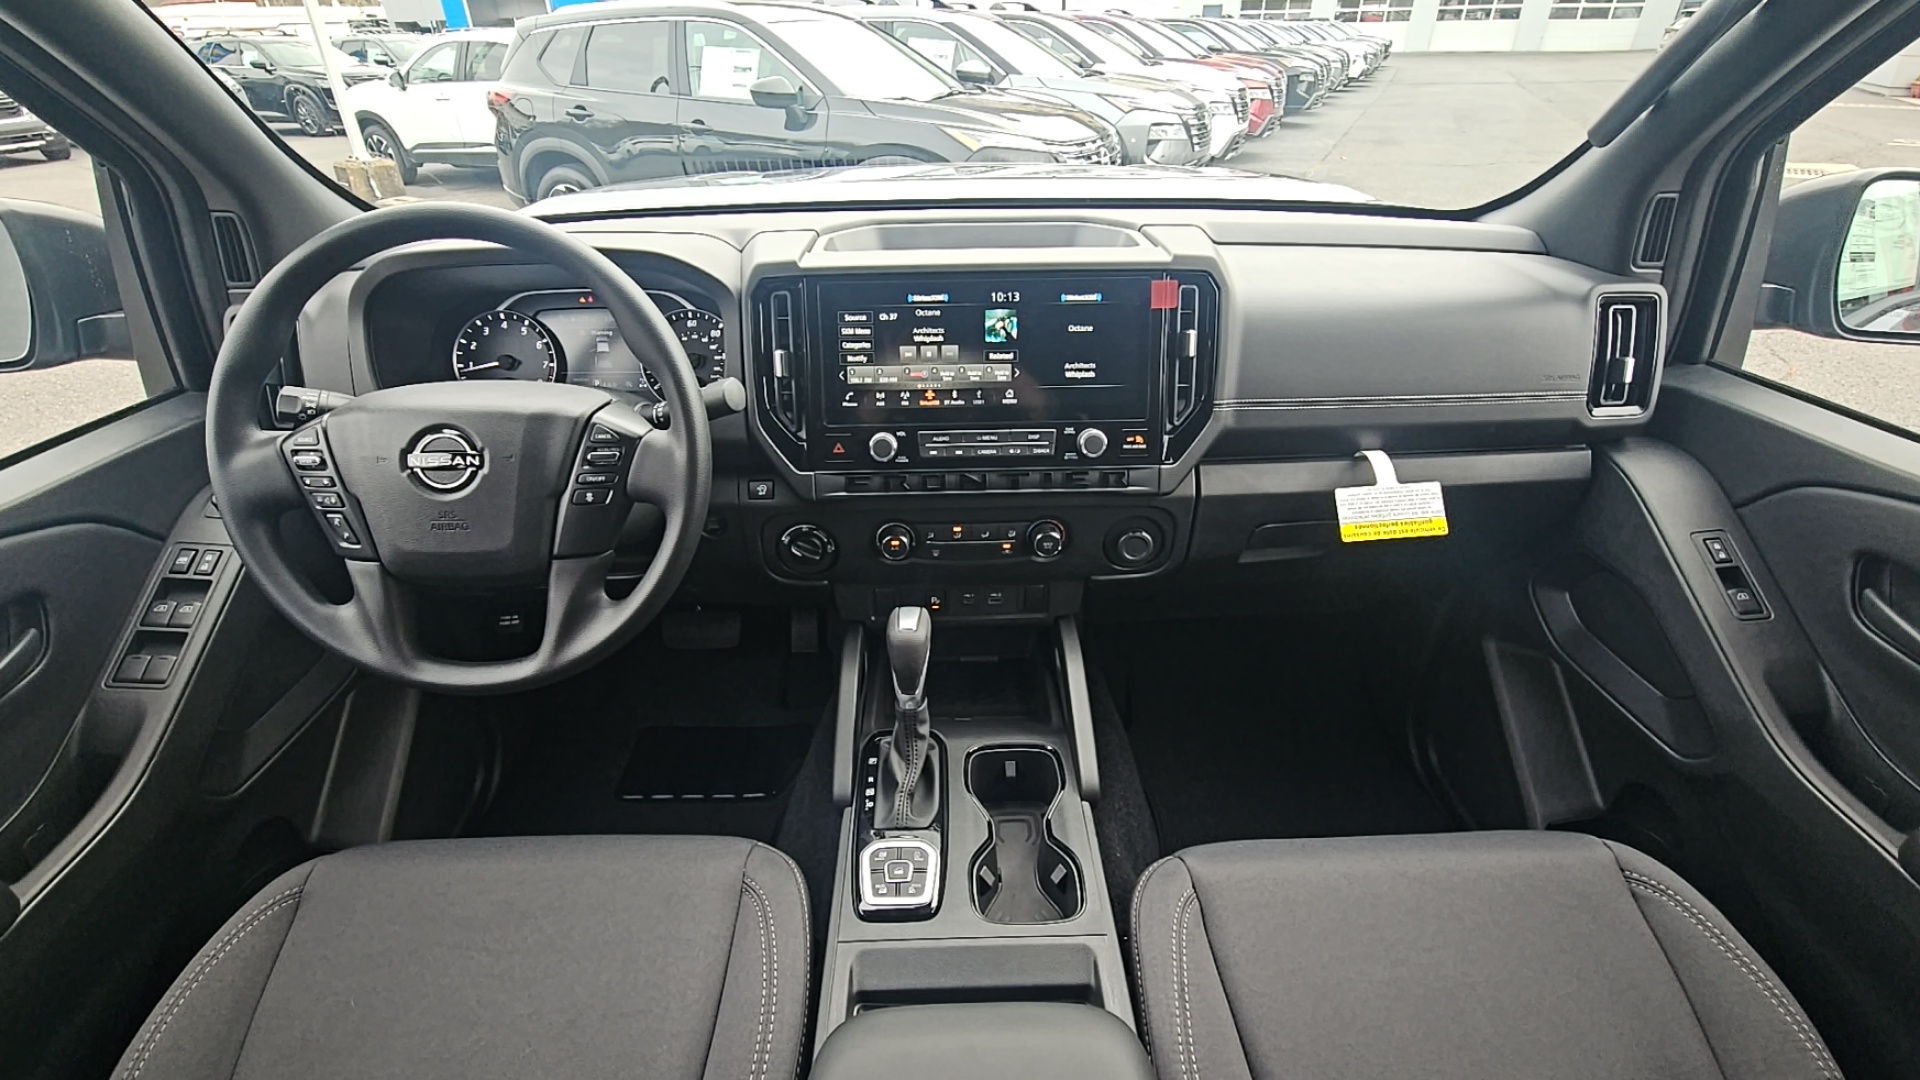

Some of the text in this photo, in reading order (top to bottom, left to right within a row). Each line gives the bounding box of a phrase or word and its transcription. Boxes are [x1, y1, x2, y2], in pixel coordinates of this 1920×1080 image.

[991, 291, 1020, 302] 10:13
[844, 313, 867, 321] Source
[879, 312, 888, 320] Ch
[501, 321, 507, 329] 4
[686, 319, 697, 327] 60
[483, 327, 489, 335] 3
[521, 327, 527, 335] 5
[710, 329, 721, 338] 80
[470, 341, 477, 350] 2
[536, 341, 542, 349] 6
[542, 361, 548, 369] 7
[408, 455, 480, 466] NISSAN
[845, 470, 1129, 491] FRONTIER
[438, 510, 457, 519] SRS
[430, 522, 470, 532] AIRBAG
